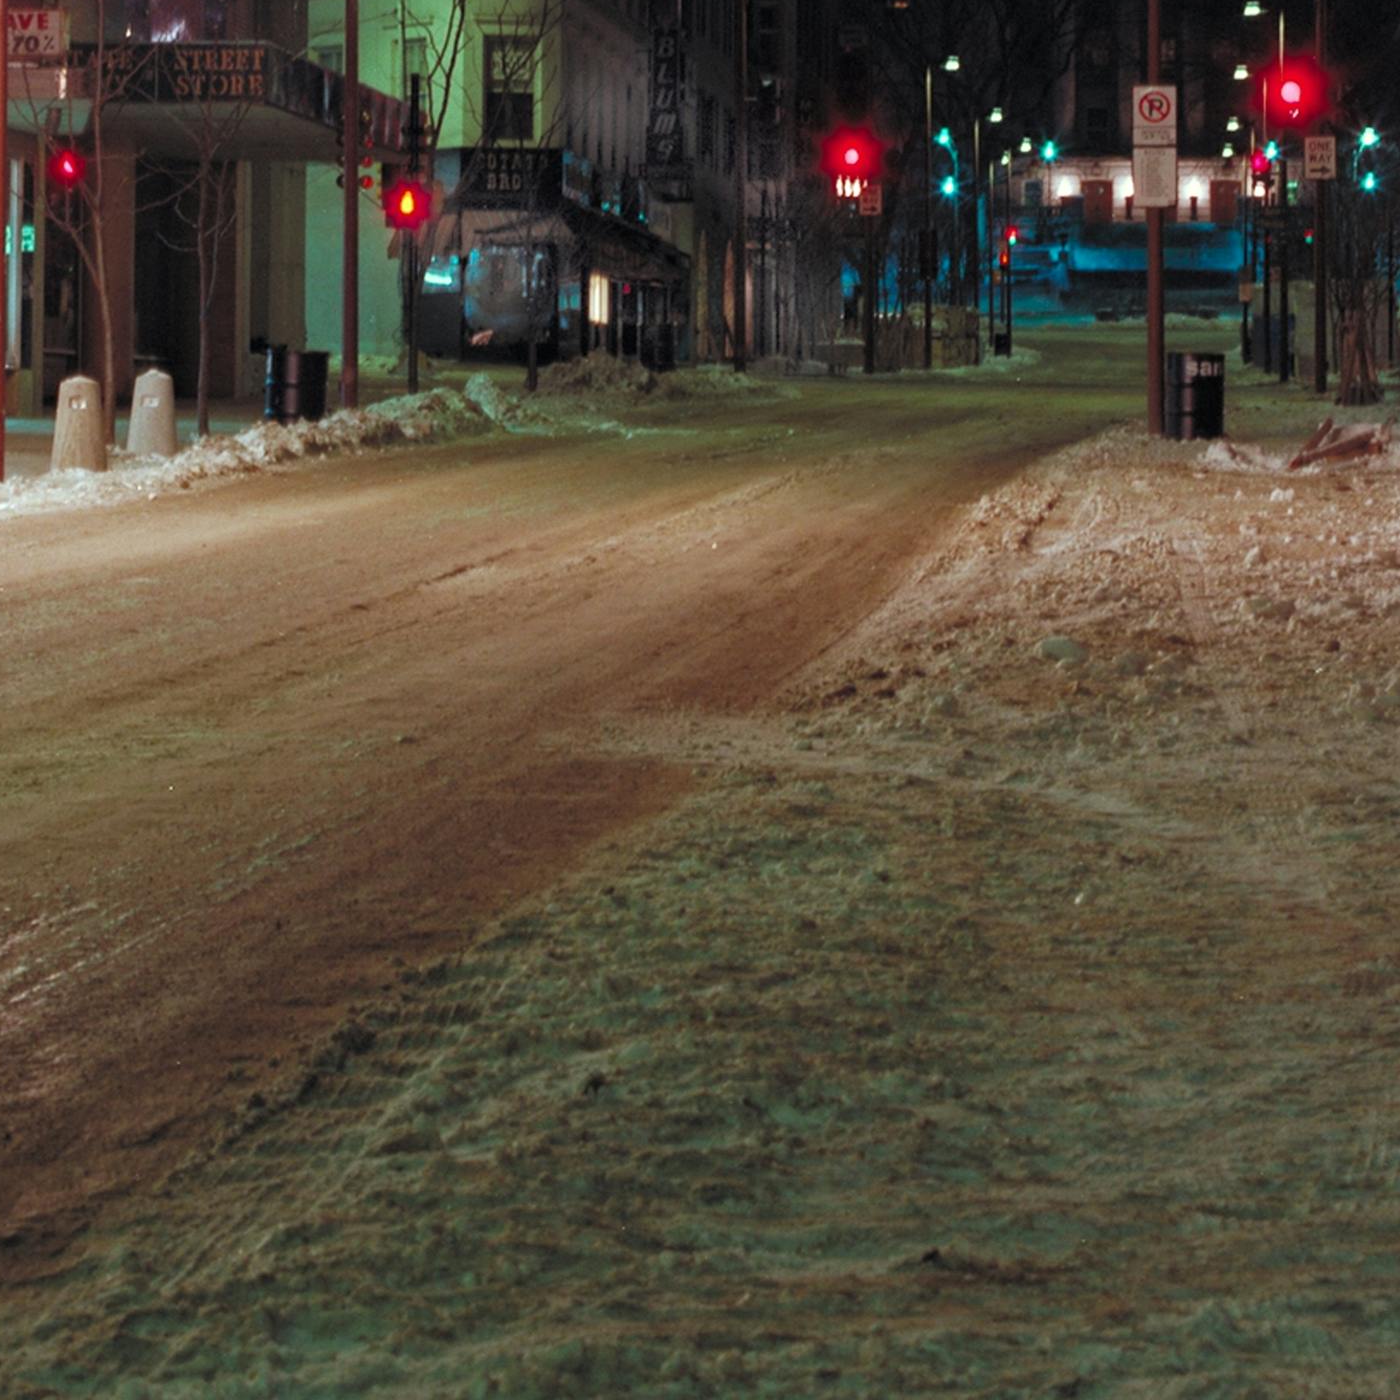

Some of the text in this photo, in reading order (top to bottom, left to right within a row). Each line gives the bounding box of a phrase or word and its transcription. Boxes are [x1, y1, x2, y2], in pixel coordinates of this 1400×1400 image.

[174, 48, 265, 71] STREET
[176, 75, 265, 95] STORE
[1308, 141, 1333, 153] ONE
